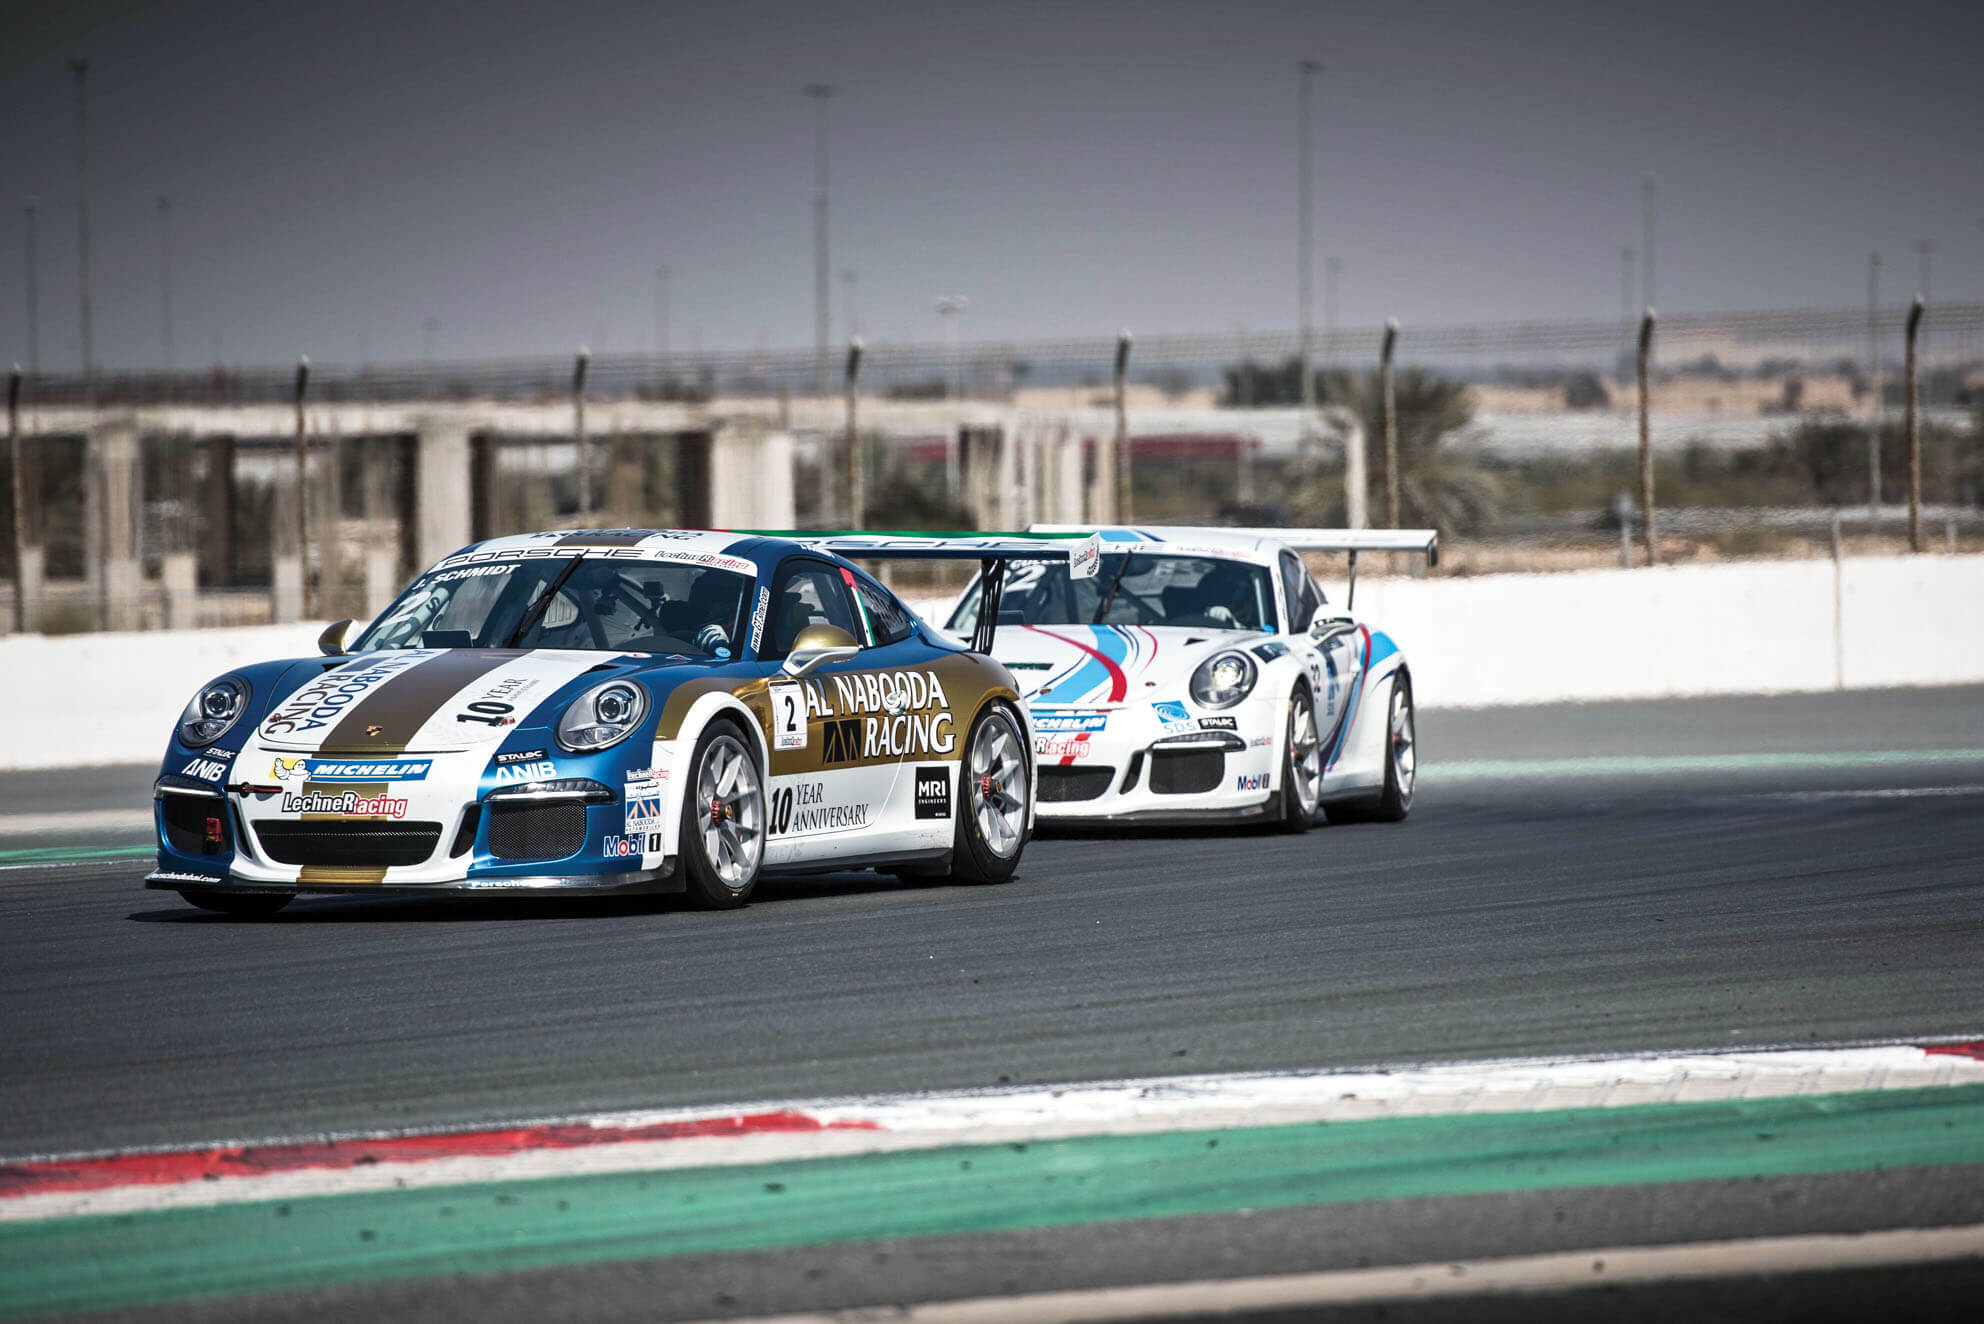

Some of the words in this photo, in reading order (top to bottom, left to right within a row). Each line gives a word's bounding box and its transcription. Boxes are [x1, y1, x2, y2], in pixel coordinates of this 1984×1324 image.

[443, 548, 645, 567] PORSCHE
[431, 564, 522, 584] SCHMIDT
[296, 662, 408, 731] NABOODA
[481, 678, 528, 698] YEAR
[805, 678, 834, 719] AL
[833, 671, 950, 715] NABOODA
[265, 674, 355, 734] RACING
[456, 701, 514, 727] 10
[785, 696, 796, 731] 2
[864, 713, 955, 758] RACING
[1164, 721, 1197, 734] SDS
[497, 750, 543, 762] STALOC
[181, 759, 227, 781] ANIB
[314, 763, 426, 776] MICHELIN
[495, 762, 557, 783] ANIB
[918, 780, 946, 797] MRI
[1237, 775, 1261, 791] Mobil
[769, 786, 793, 835] 10
[795, 783, 824, 805] YEAR
[792, 803, 870, 832] ANNIVERSARY
[603, 834, 645, 857] Mobil
